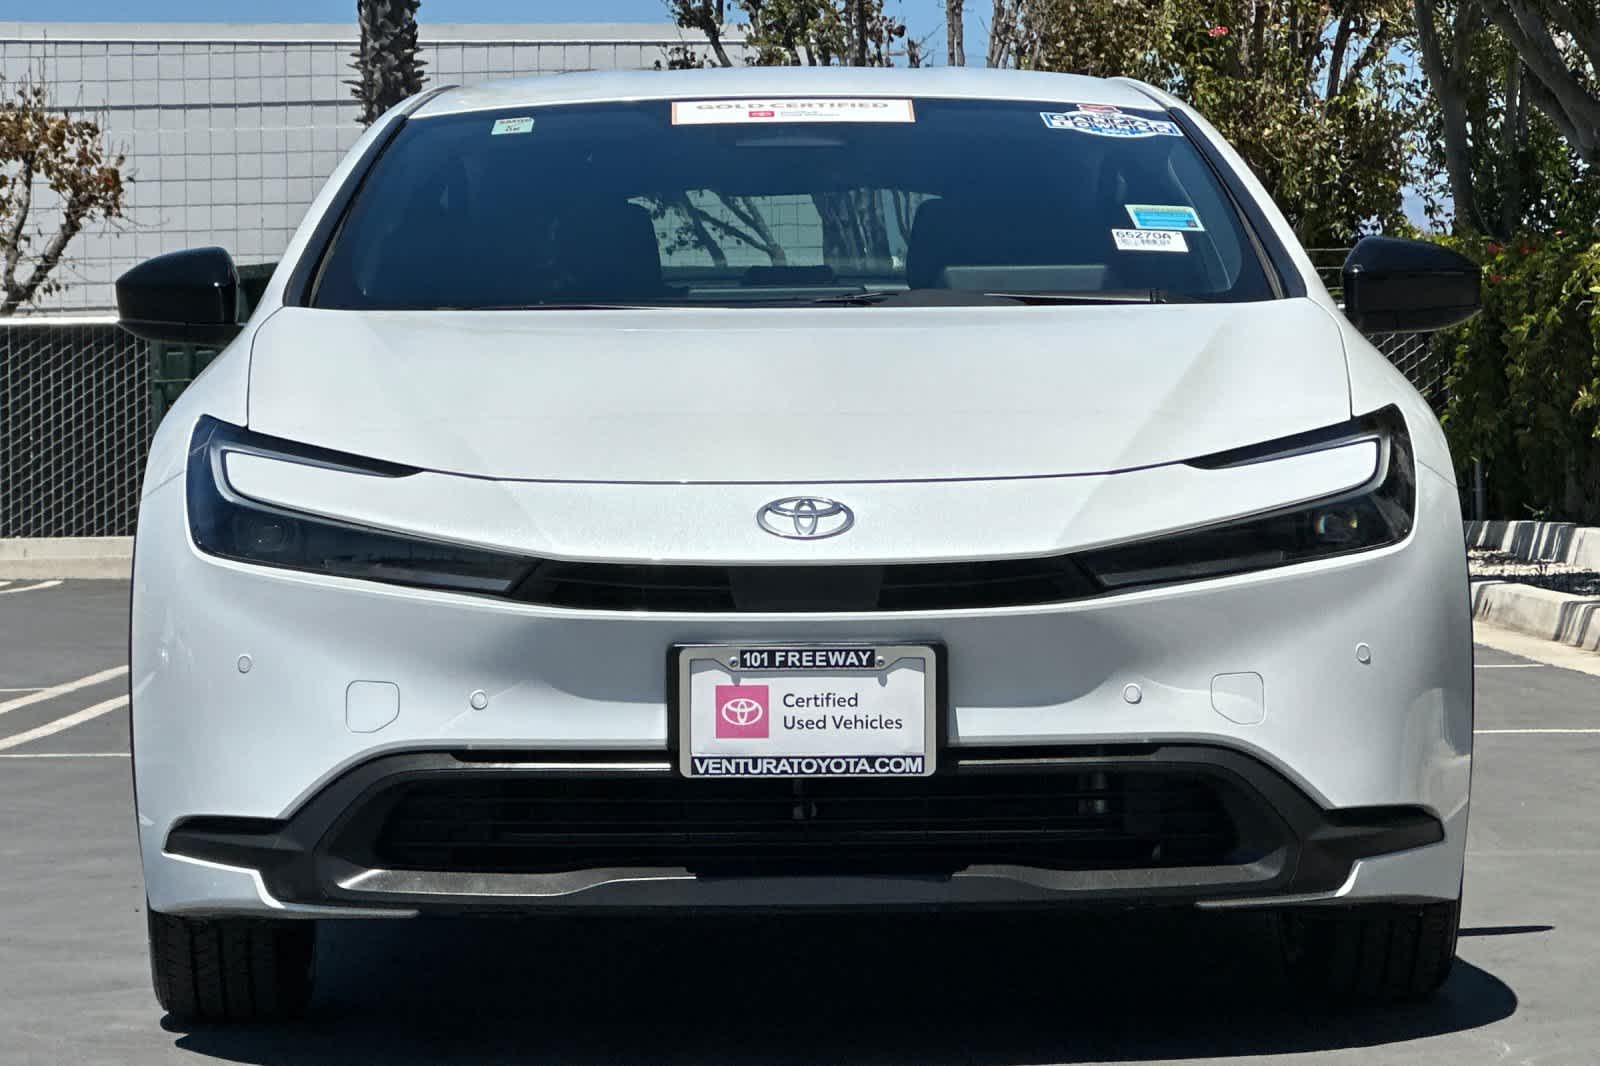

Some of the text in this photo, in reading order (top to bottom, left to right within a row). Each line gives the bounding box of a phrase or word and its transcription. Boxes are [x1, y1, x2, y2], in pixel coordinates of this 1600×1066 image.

[743, 651, 871, 667] 101 FREEWAY
[783, 692, 858, 708] Certified
[783, 714, 903, 729] Used Vehicles
[694, 757, 923, 774] VENTURATOYOTA.COM
